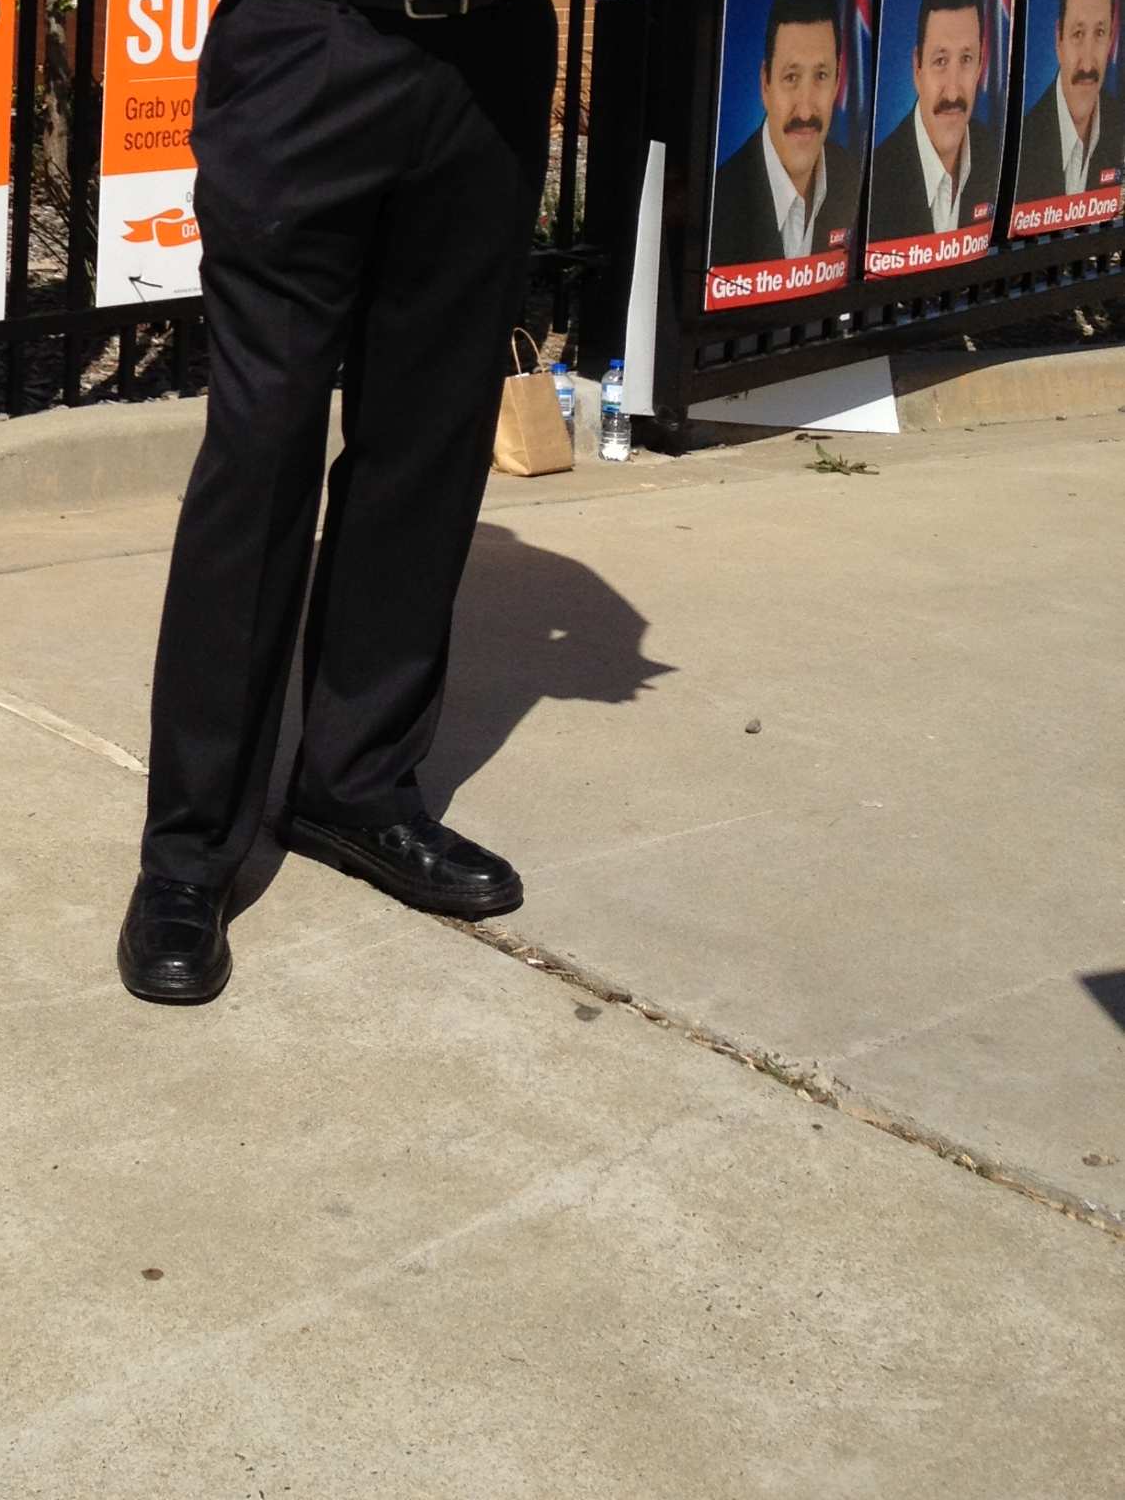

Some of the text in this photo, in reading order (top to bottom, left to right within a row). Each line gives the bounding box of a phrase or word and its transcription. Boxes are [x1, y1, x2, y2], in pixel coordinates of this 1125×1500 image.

[125, 97, 191, 122] Grab yo
[124, 128, 192, 150] scoreca
[1014, 197, 1118, 231] Gets the Job Done
[868, 249, 905, 273] Gets
[908, 244, 933, 267] the
[935, 238, 960, 261] Job
[712, 260, 846, 299] Gets the Job Done
